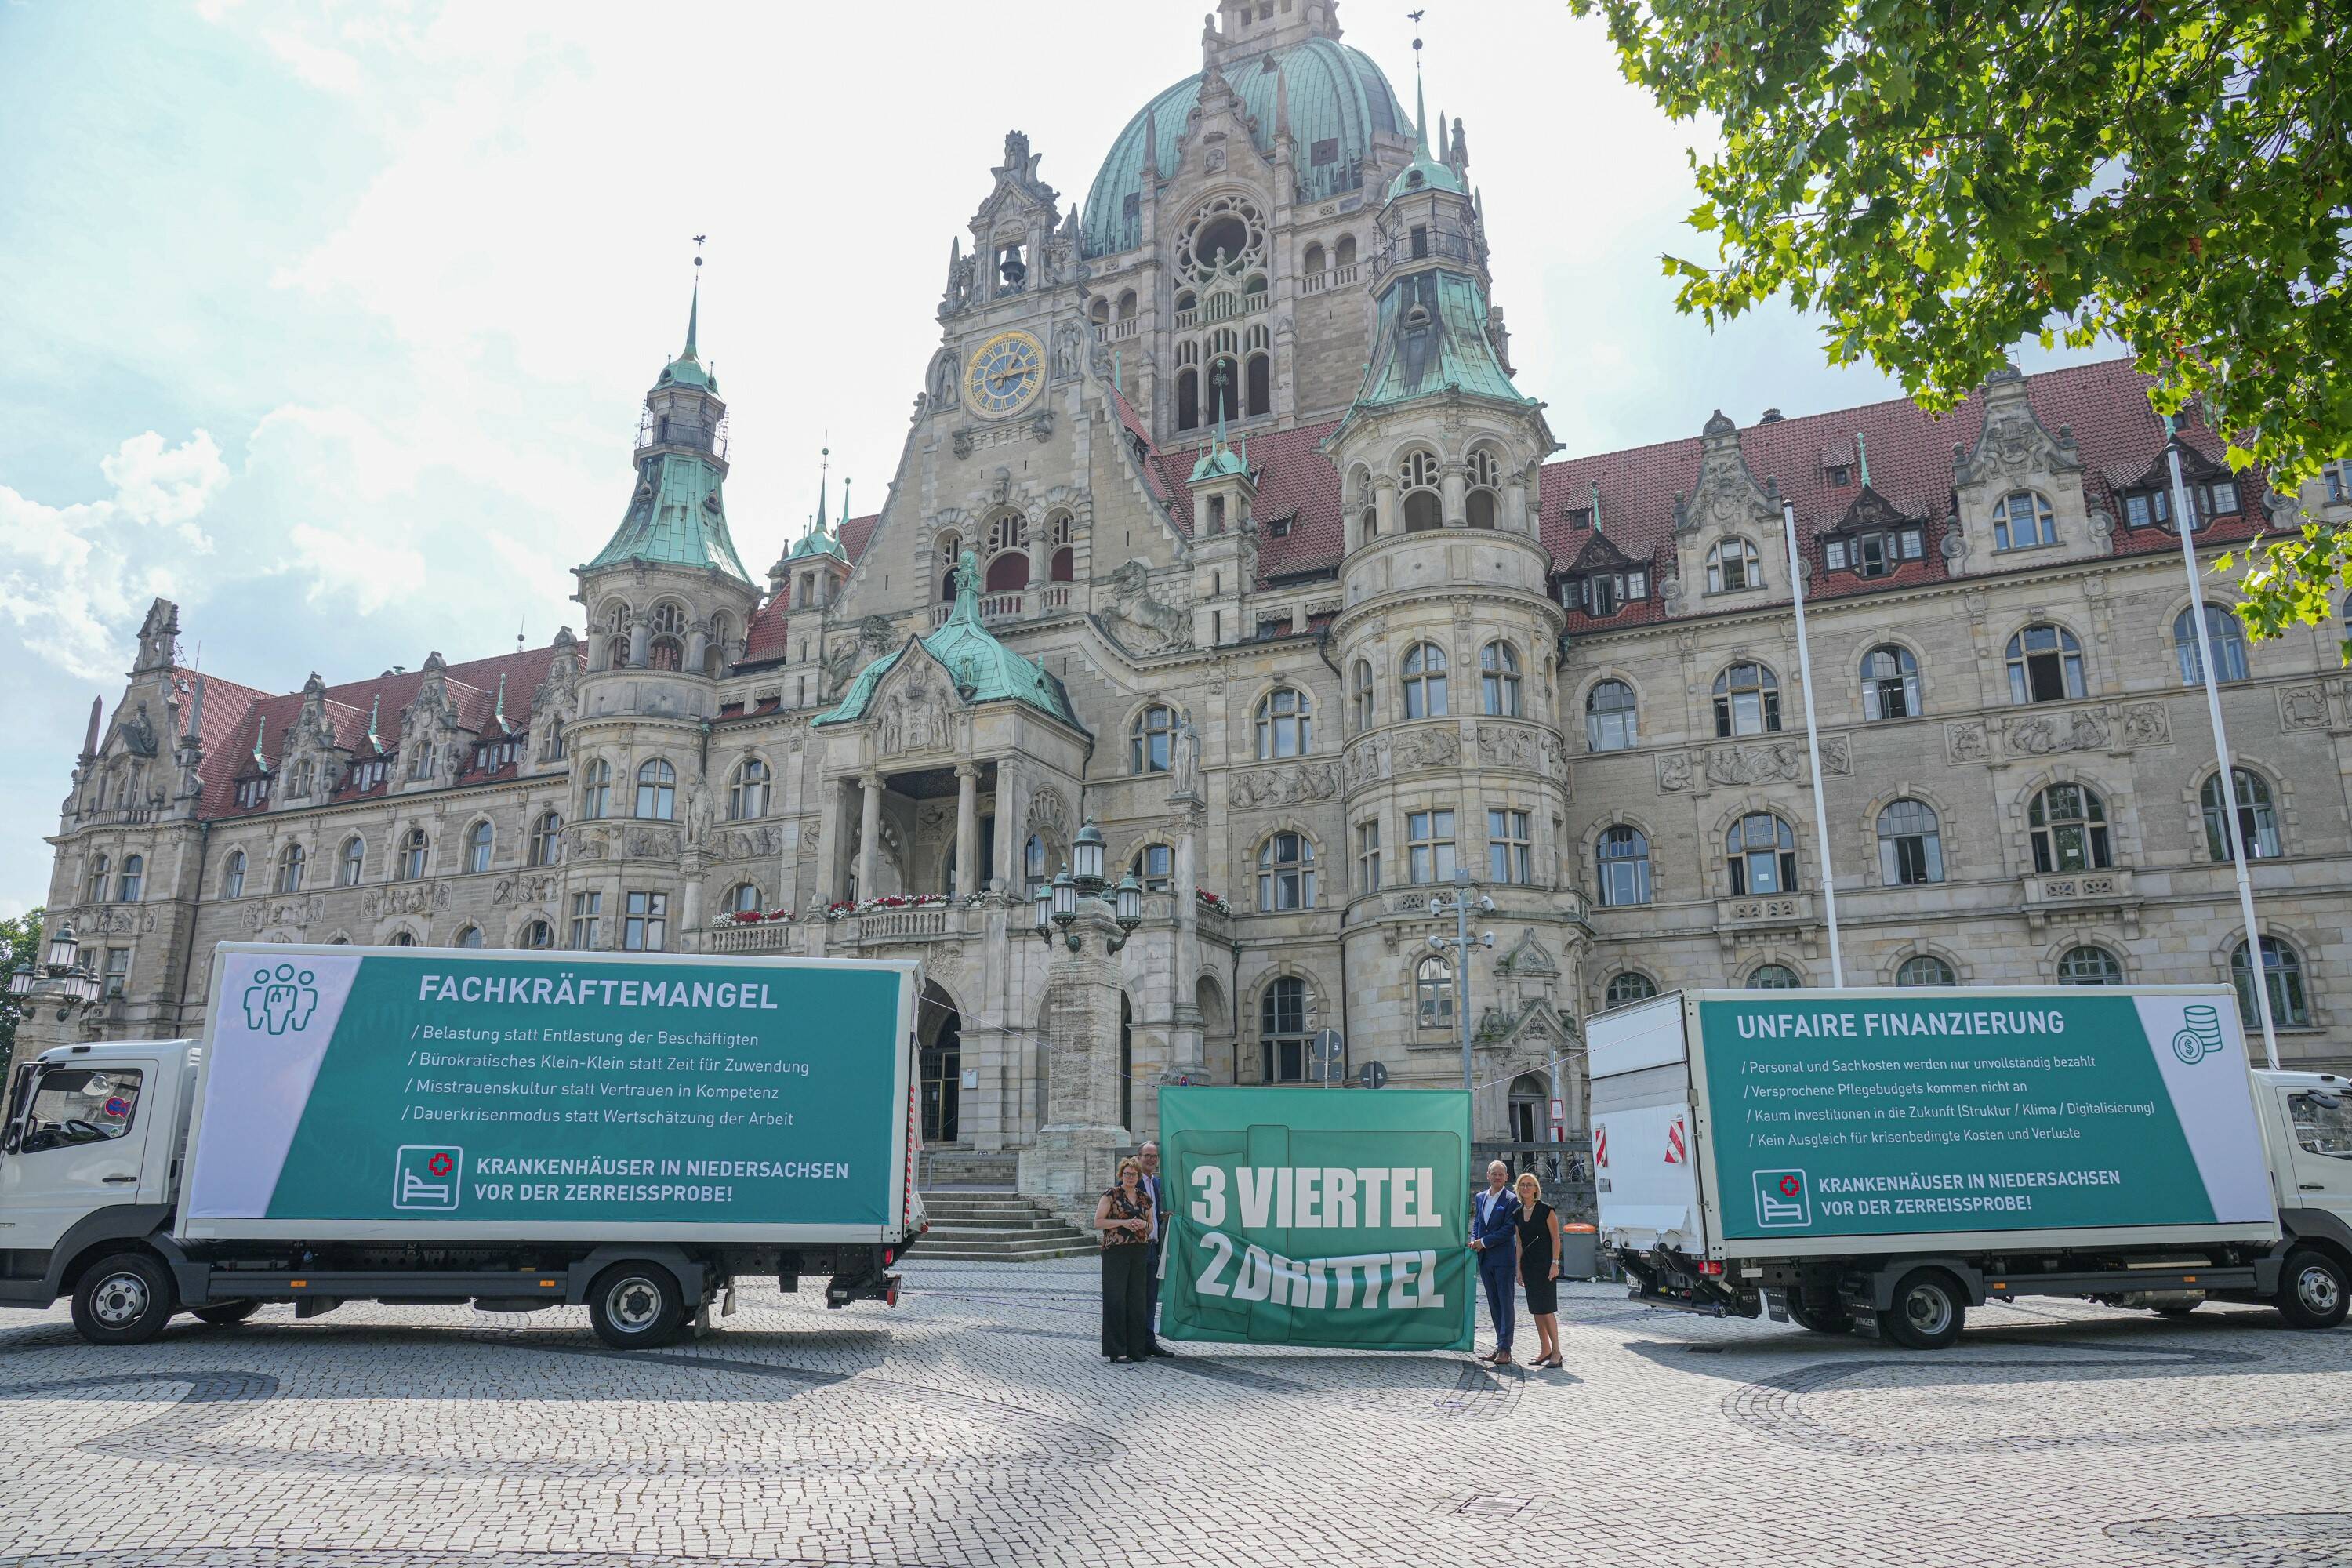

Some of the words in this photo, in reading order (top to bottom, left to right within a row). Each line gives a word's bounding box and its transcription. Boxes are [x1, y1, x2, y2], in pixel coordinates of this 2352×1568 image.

[419, 972, 779, 1010] FACHKRÄFTEMANGEL
[1737, 1013, 1857, 1039] UNFAIRE
[1864, 1011, 2064, 1036] FINANZIERUNG
[423, 1025, 499, 1044] Belastung
[504, 1029, 539, 1041] statt
[543, 1028, 623, 1047] Entlastung
[628, 1030, 654, 1044] der
[658, 1030, 759, 1049] Beschäftigten
[419, 1051, 536, 1068] Bürokratisches
[540, 1054, 625, 1069] Klein-Klein
[629, 1058, 663, 1070] statt
[666, 1057, 695, 1071] Zeit
[699, 1058, 721, 1071] für
[724, 1058, 809, 1077] Zuwendung
[1749, 1060, 1804, 1073] Personal
[1806, 1060, 1829, 1073] und
[1832, 1059, 1900, 1072] Sachkosten
[1903, 1058, 1947, 1070] werden
[1950, 1060, 1970, 1069] nur
[1973, 1056, 2051, 1071] unvollständig
[2053, 1055, 2096, 1068] bezahlt
[416, 1079, 557, 1095] Misstrauenskultur
[561, 1083, 596, 1096] statt
[600, 1082, 673, 1097] Vertrauen
[678, 1083, 691, 1097] in
[696, 1084, 779, 1102] Kompetenz
[1751, 1084, 1835, 1100] Versprochene
[1838, 1083, 1924, 1098] Pflegebudgets
[1926, 1082, 1978, 1094] kommen
[1981, 1080, 2010, 1092] nicht
[2013, 1083, 2027, 1092] an
[413, 1105, 561, 1122] Dauerkrisenmodus
[564, 1110, 599, 1123] statt
[604, 1109, 715, 1128] Wertschätzung
[720, 1111, 745, 1125] der
[748, 1111, 793, 1126] Arbeit
[1755, 1109, 1791, 1122] Kaum
[1794, 1108, 1871, 1120] Investitionen
[1874, 1109, 1885, 1119] in
[1888, 1106, 1906, 1119] die
[1908, 1105, 1955, 1118] Zukunft
[1958, 1104, 2012, 1118] (Struktur
[2022, 1103, 2056, 1116] Klima
[2067, 1100, 2154, 1117] Digitalisierung)
[1757, 1134, 1784, 1146] Kein
[1788, 1132, 1847, 1149] Ausgleich
[1850, 1131, 1868, 1144] für
[1871, 1130, 1961, 1145] krisenbedingte
[1963, 1129, 2005, 1142] Kosten
[2007, 1127, 2030, 1140] und
[2031, 1127, 2081, 1139] Verluste
[477, 1155, 655, 1176] KRANKENHÄUSER
[660, 1160, 681, 1176] IN
[686, 1160, 848, 1179] NIEDERSACHSEN
[474, 1183, 514, 1200] VOR
[520, 1184, 560, 1200] DER
[564, 1184, 733, 1202] ZERREISSPROBE!
[1818, 1172, 1964, 1193] KRANKENHÄUSER
[1967, 1174, 1985, 1189] IN
[1988, 1170, 2121, 1189] NIEDERSACHSEN
[1192, 1166, 1226, 1227] 3
[1236, 1167, 1442, 1228] VIERTEL
[1820, 1200, 1855, 1217] VOR
[1857, 1200, 1892, 1215] DER
[1894, 1195, 2032, 1214] ZERREISSPROBE!
[1196, 1232, 1232, 1296] 2
[1232, 1243, 1445, 1308] DRITTEL
